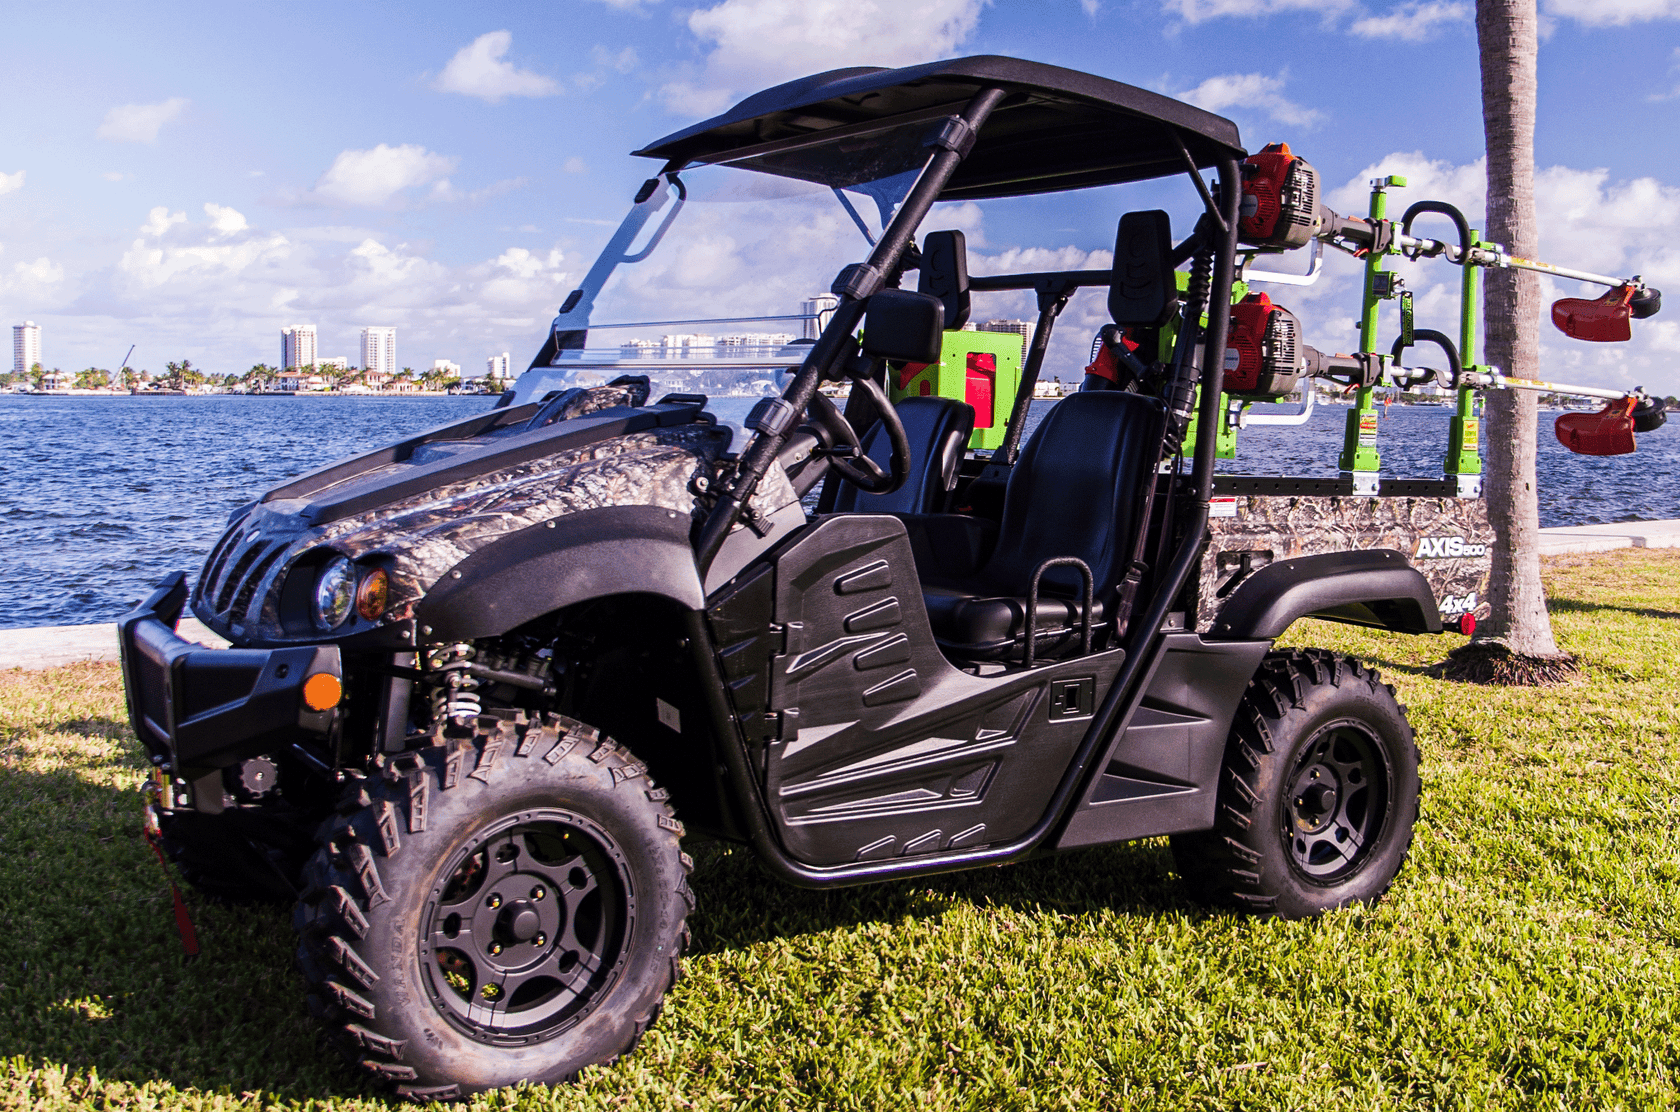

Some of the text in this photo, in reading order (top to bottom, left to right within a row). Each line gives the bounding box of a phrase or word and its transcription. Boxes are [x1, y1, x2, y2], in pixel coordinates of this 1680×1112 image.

[1416, 537, 1485, 558] AXIS 500
[1438, 593, 1476, 613] 4x4
[391, 918, 411, 1008] WANDA
